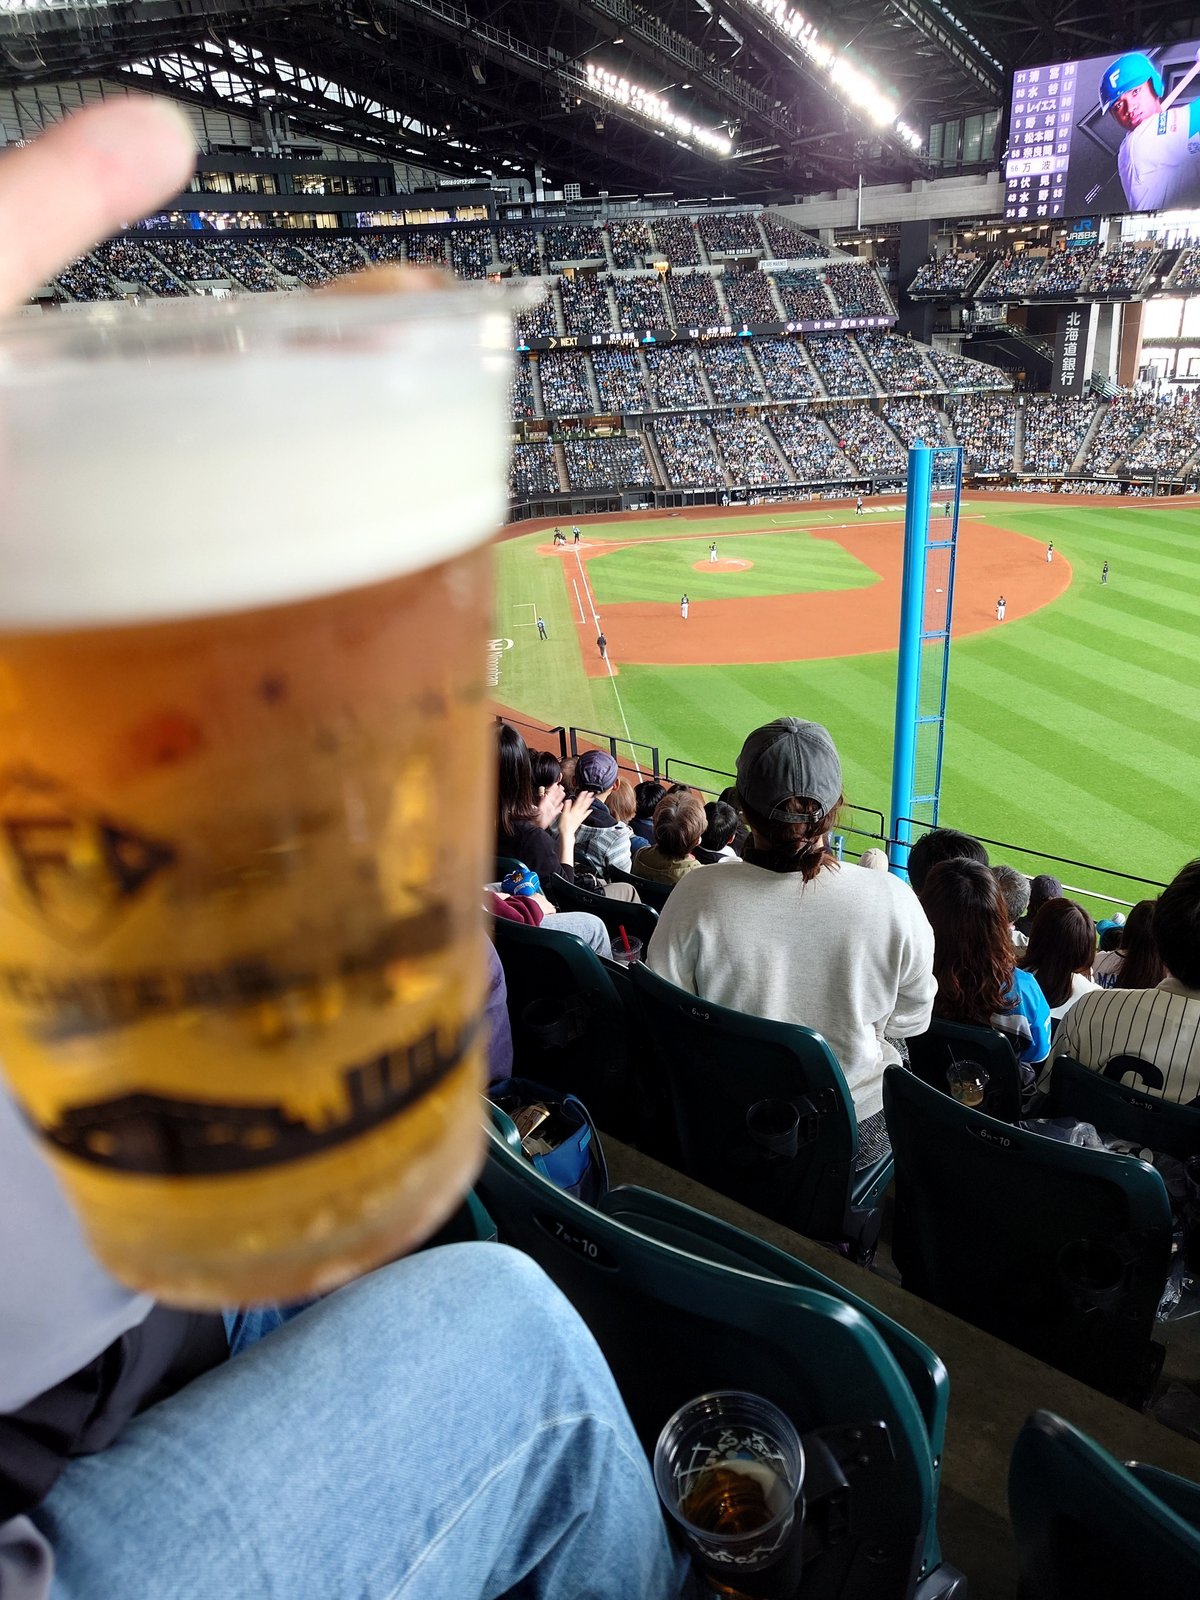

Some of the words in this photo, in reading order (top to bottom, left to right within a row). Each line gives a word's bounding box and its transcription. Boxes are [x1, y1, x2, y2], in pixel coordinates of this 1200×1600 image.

[1109, 68, 1120, 88] F
[1027, 99, 1056, 113] レイエス
[1014, 134, 1020, 143] 7
[1010, 164, 1018, 173] 66
[1022, 160, 1051, 173] 万波
[1008, 179, 1018, 188] 23
[1020, 175, 1050, 188] 伏見
[1019, 189, 1049, 203] 水野
[1006, 209, 1015, 217] 24
[1018, 204, 1047, 217] 金村
[1053, 204, 1059, 214] P
[1073, 219, 1092, 232] JR
[1066, 231, 1098, 240] JR西日本
[560, 337, 578, 346] NEXT
[1060, 311, 1081, 386] 北海道銀行
